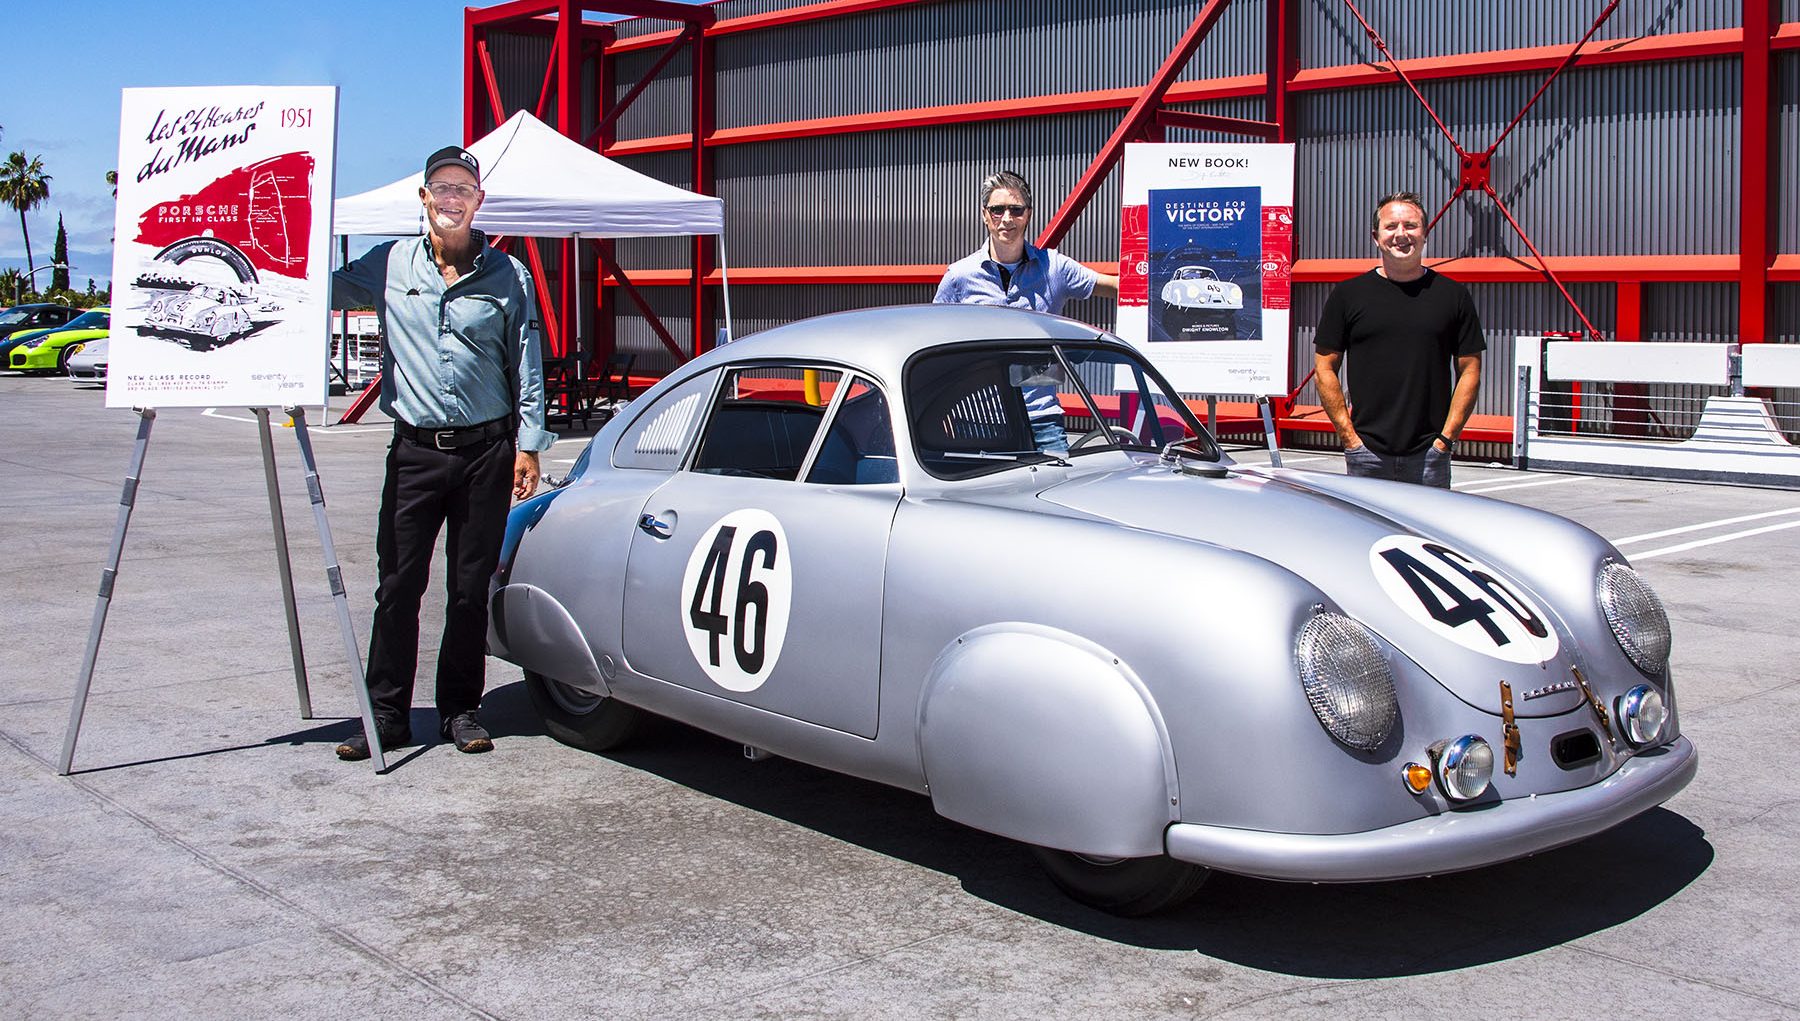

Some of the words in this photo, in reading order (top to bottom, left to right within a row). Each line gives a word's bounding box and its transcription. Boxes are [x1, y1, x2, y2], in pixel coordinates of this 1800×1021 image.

[178, 107, 207, 135] 24
[201, 101, 264, 131] Heures
[281, 108, 312, 128] 1951
[137, 147, 174, 183] du
[173, 123, 256, 168] Mans
[1168, 158, 1200, 168] NEW
[1205, 158, 1249, 168] BOOK!
[158, 204, 239, 216] PORSCHE
[1165, 201, 1219, 210] DESTINED
[158, 216, 187, 224] FIRST
[207, 215, 238, 223] CLASS
[1166, 208, 1246, 222] VICTORY
[191, 247, 227, 257] DUNLOP
[1137, 263, 1147, 273] 46
[251, 373, 288, 382] seventy
[1228, 368, 1256, 377] seventy
[1249, 375, 1270, 383] years
[278, 382, 304, 390] years
[690, 525, 777, 675] 46
[1378, 543, 1549, 647] 46
